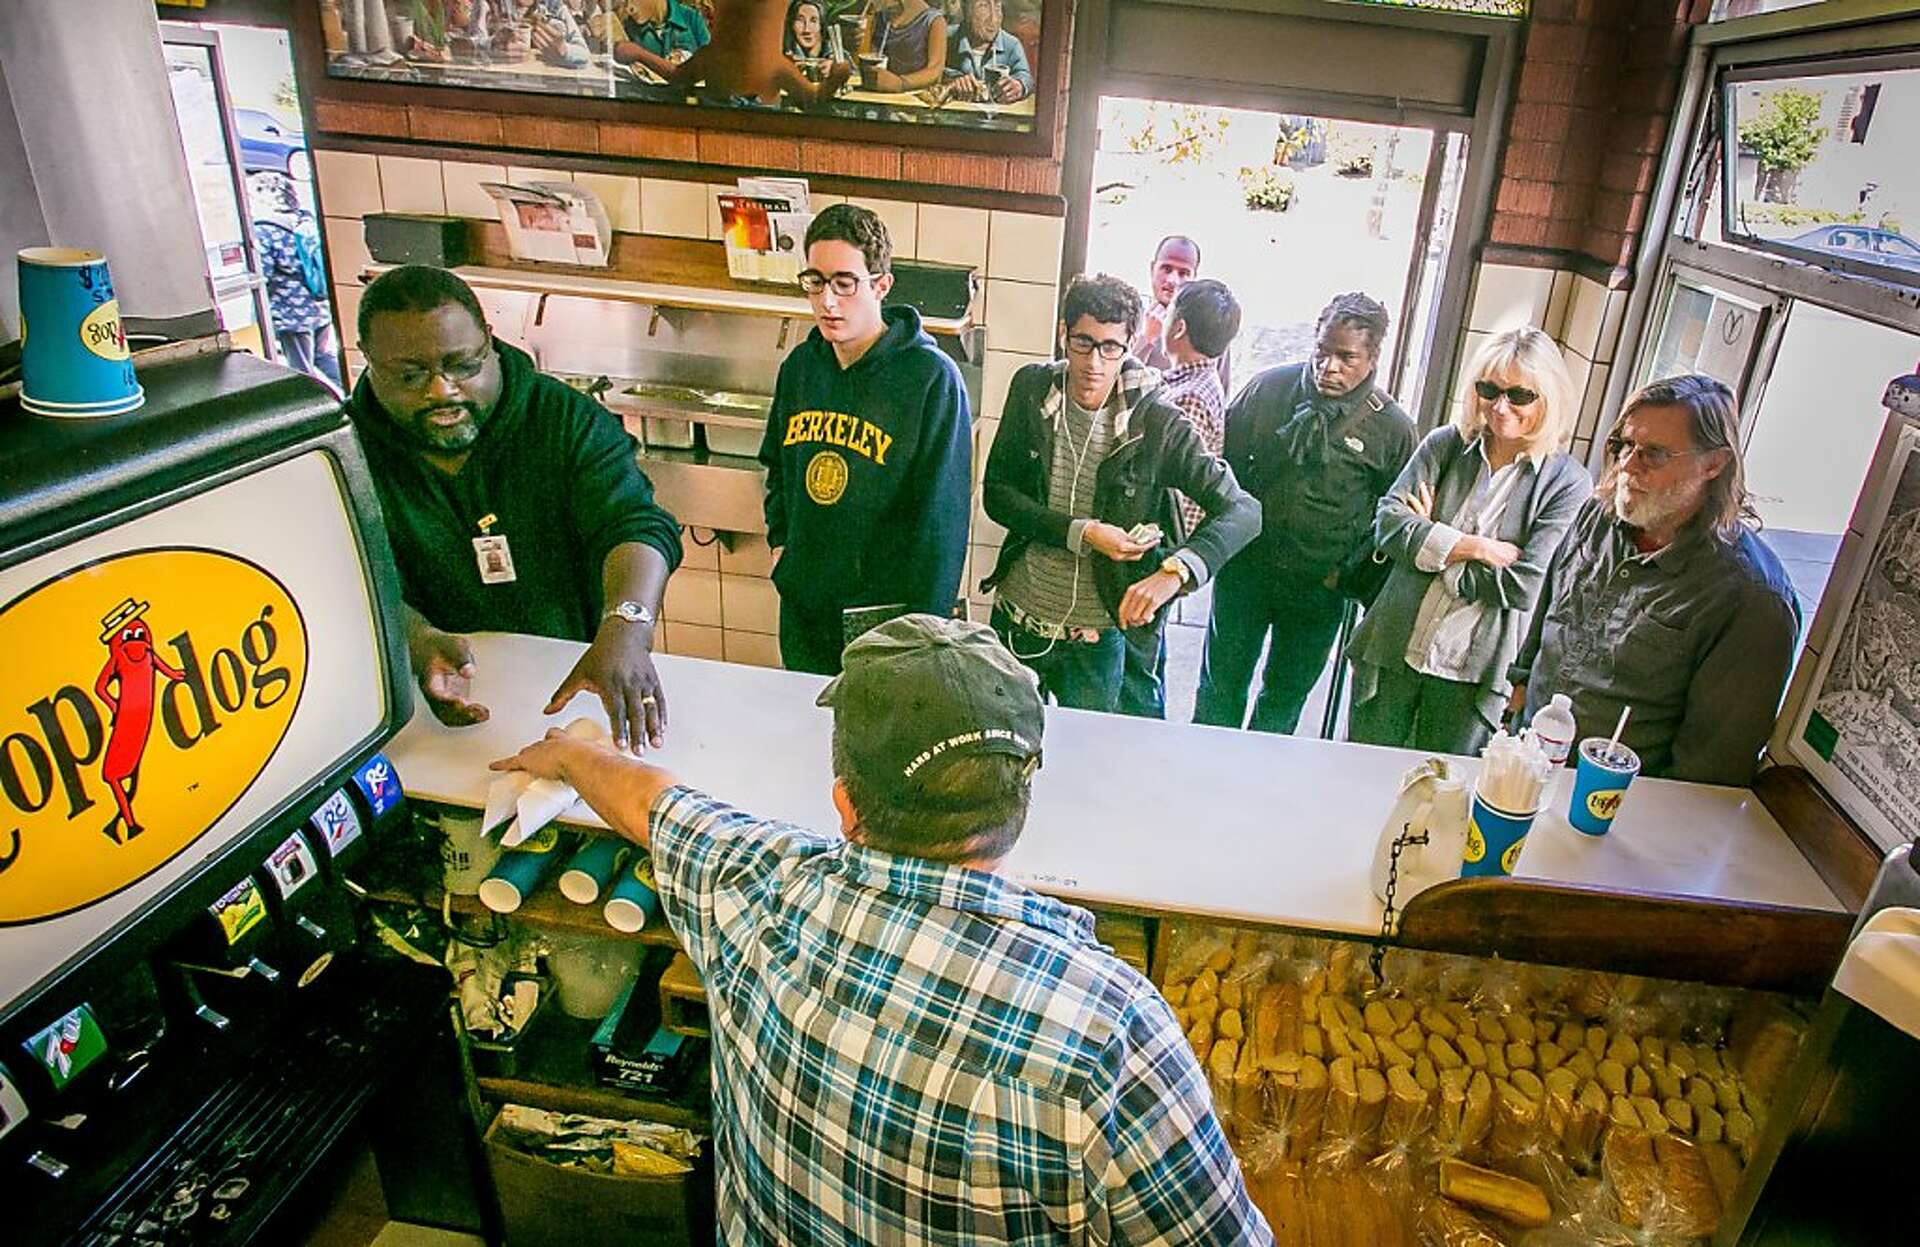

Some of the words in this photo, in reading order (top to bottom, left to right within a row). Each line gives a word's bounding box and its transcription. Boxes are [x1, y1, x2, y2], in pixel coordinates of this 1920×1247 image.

[783, 410, 893, 466] BERKELEY
[0, 684, 104, 872] op
[161, 604, 292, 750] dog
[904, 751, 931, 778] HARD
[932, 742, 946, 755] AT
[948, 731, 982, 748] WORK
[366, 761, 389, 795] RC
[323, 803, 348, 837] RC
[619, 1068, 654, 1084] 721
